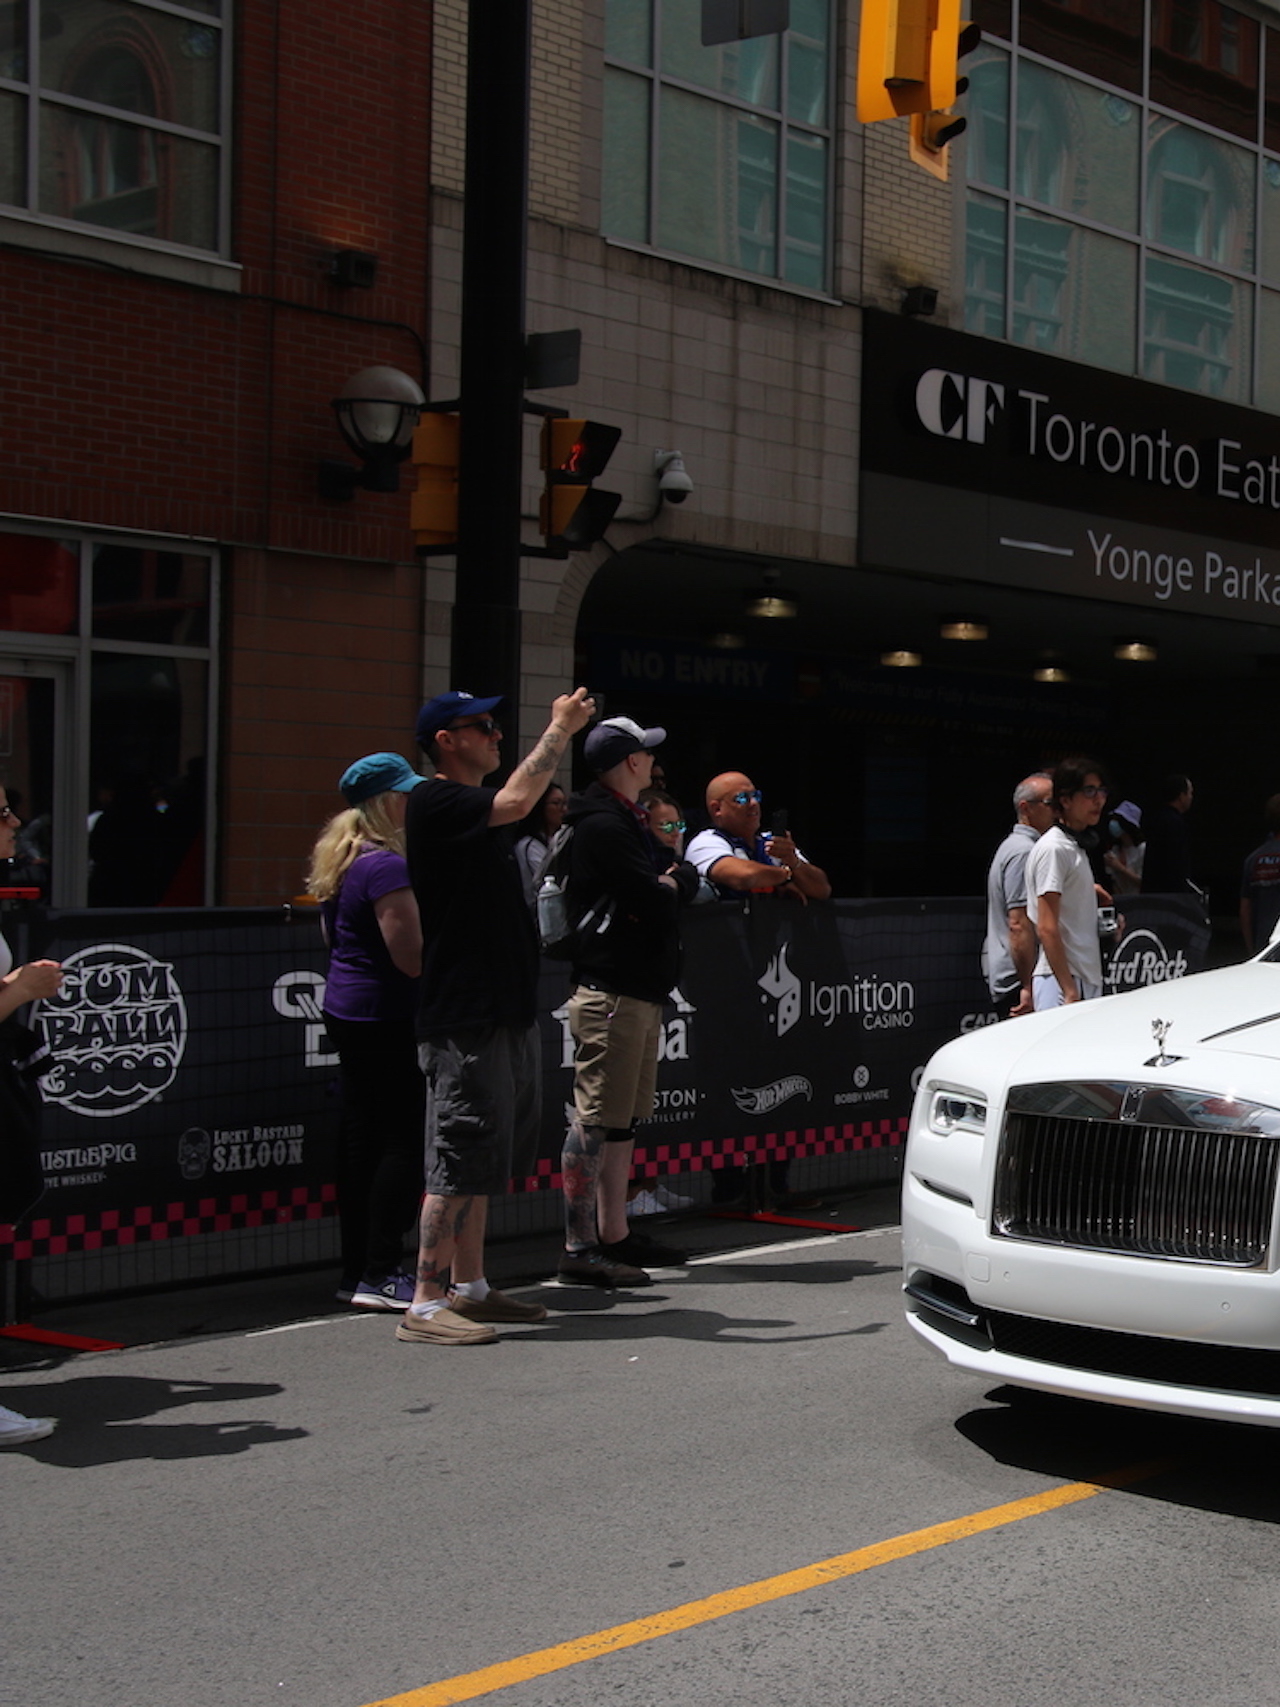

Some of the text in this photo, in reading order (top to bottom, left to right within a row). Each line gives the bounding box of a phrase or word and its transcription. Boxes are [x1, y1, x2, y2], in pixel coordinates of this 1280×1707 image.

[916, 368, 1004, 444] CF
[1018, 389, 1200, 490] Toronto
[1087, 530, 1194, 600] Yonge
[619, 649, 771, 688] NO ENTRY
[1104, 949, 1189, 986] ard Rock
[809, 973, 915, 1027] Ignition
[37, 1004, 179, 1056] BALL
[862, 1010, 914, 1031] CASINO
[653, 1087, 698, 1110] STON
[863, 1088, 890, 1102] WHITE
[212, 1124, 305, 1146] LUCKY BASTARD
[212, 1139, 304, 1173] SALOON
